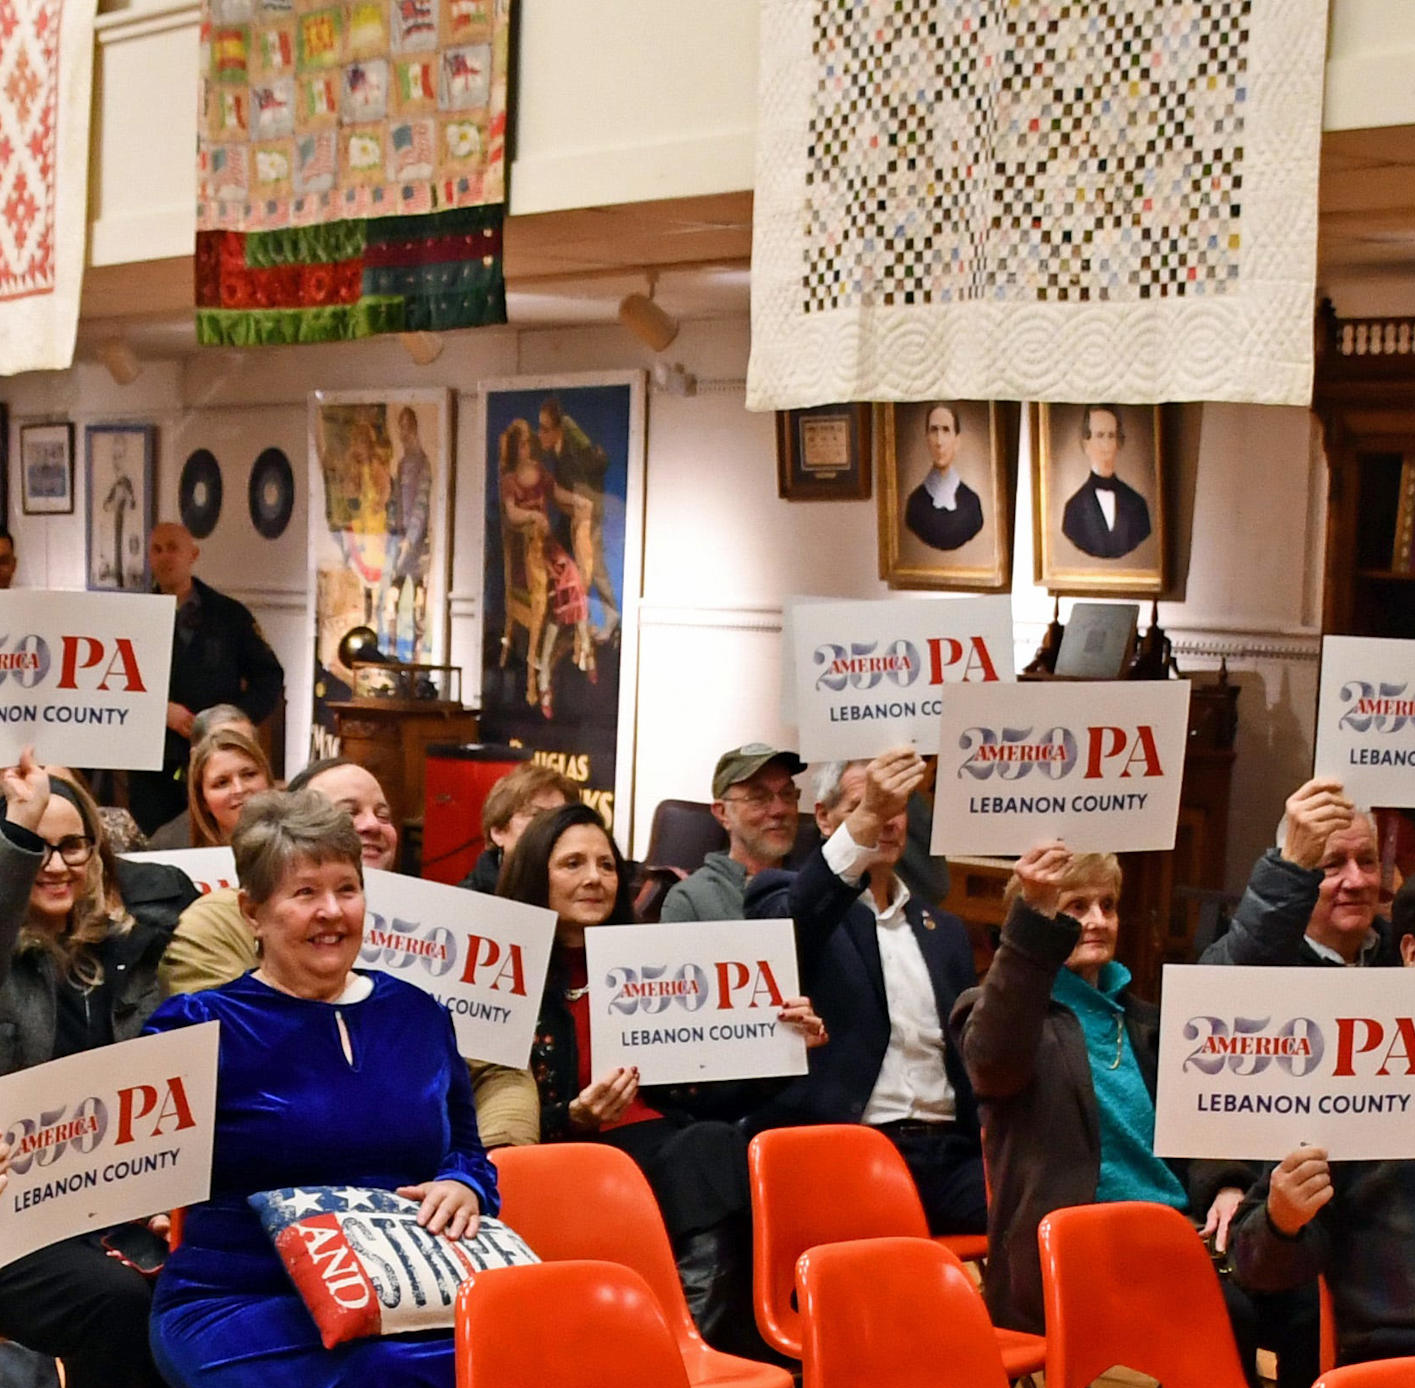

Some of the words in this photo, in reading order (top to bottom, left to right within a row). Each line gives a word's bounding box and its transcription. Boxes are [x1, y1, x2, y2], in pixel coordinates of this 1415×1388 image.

[57, 635, 148, 693] PA
[814, 640, 921, 691] 250
[926, 636, 1000, 686] PA
[828, 655, 913, 675] AMERICA
[43, 706, 128, 725] COUNTY
[830, 703, 915, 721] LEBANON
[958, 727, 1078, 780] 250
[1084, 725, 1165, 780] PA
[972, 743, 1068, 763] AMERICA
[970, 797, 1065, 813] LEBANON
[1072, 794, 1147, 812] COUNTY
[363, 929, 448, 961] AMERICA
[459, 933, 528, 997] PA
[606, 964, 709, 1015] 250
[714, 960, 784, 1010] PA
[620, 979, 700, 999] AMERICA
[446, 996, 512, 1024] COUNTY
[622, 1027, 703, 1046] LEBANON
[708, 1020, 777, 1041] COUNTY
[1183, 1016, 1324, 1077] 250
[1202, 1035, 1311, 1057] AMERICA
[1198, 1094, 1310, 1113] LEBANON
[1319, 1095, 1411, 1113] COUNTY
[4, 1096, 111, 1176] 250
[114, 1076, 197, 1147] PA
[17, 1115, 99, 1155] AMERICA
[12, 1172, 97, 1214] LEBANON
[102, 1146, 180, 1183] COUNTY
[298, 1222, 371, 1310] AND
